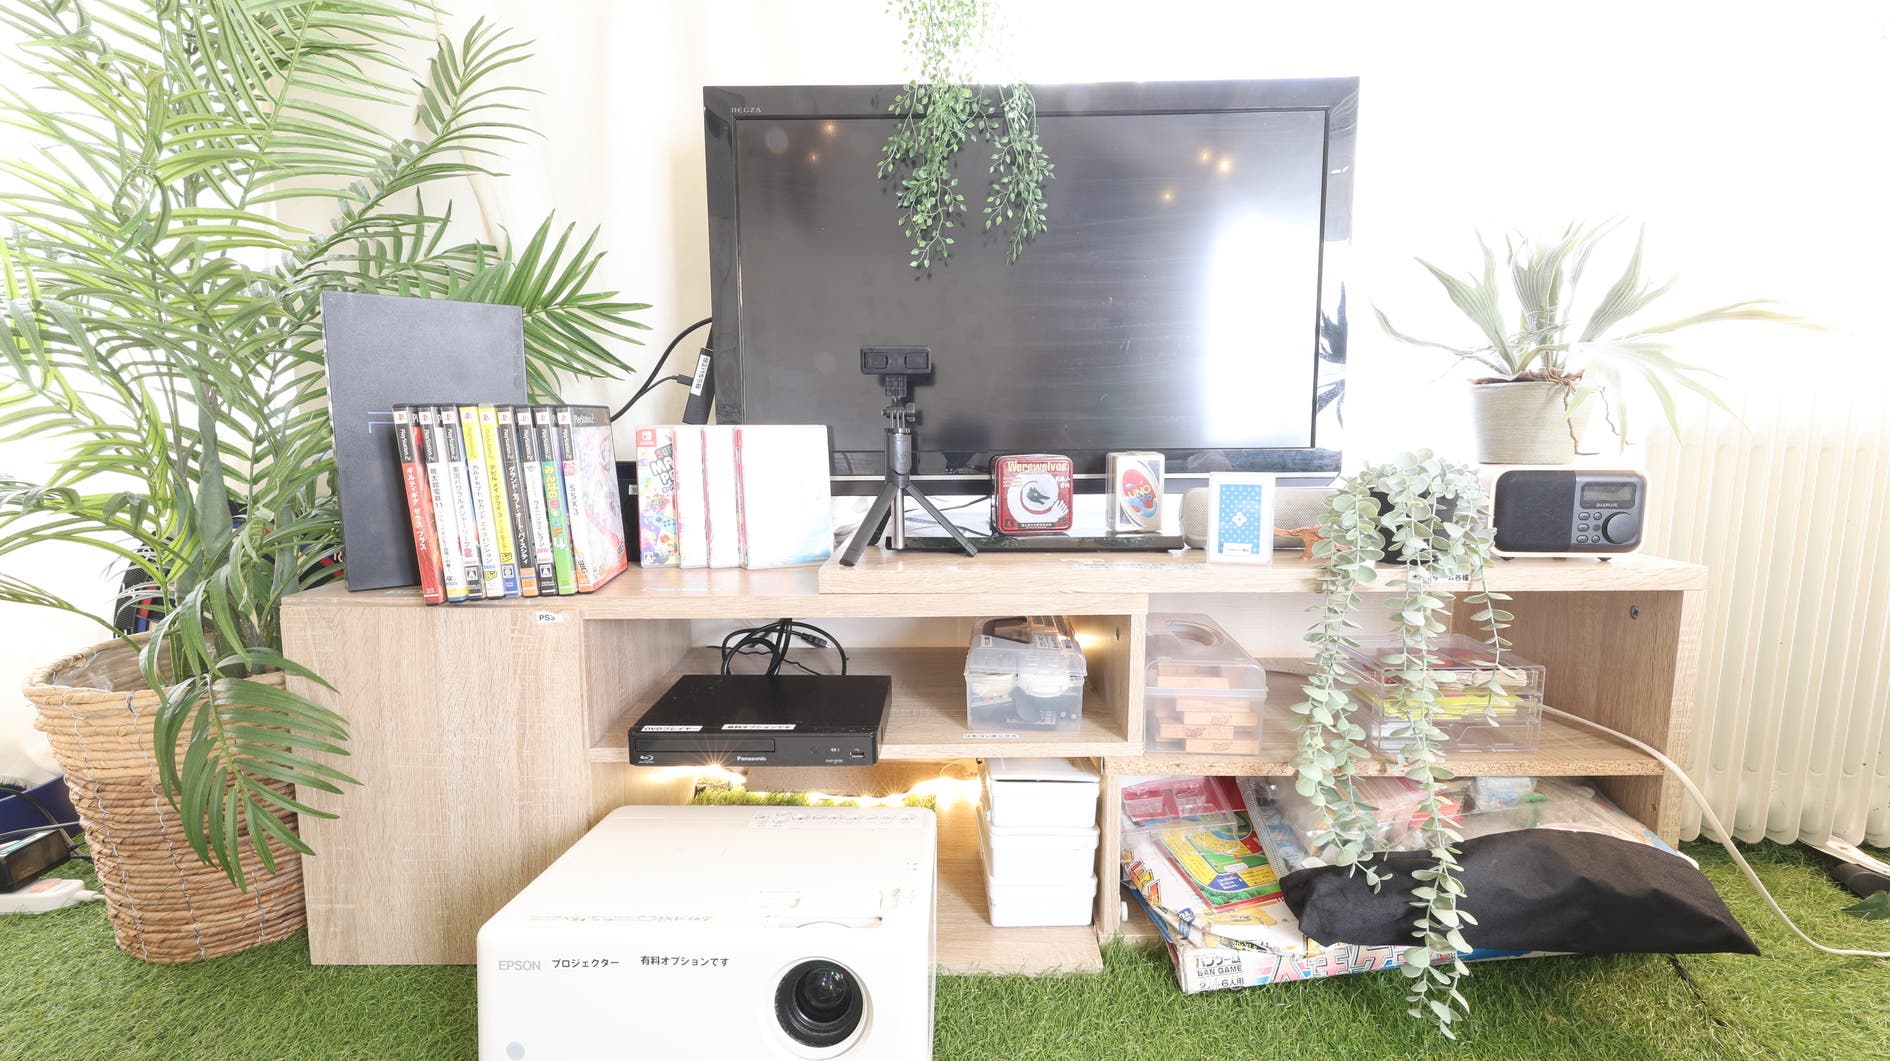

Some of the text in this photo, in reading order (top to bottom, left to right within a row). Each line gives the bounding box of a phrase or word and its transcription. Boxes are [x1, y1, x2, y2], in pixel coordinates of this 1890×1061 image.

[1128, 484, 1151, 498] UNO
[498, 960, 541, 971] EPSON
[551, 955, 730, 969] プロジェクター 有料オプションです
[1217, 964, 1242, 975] GAME
